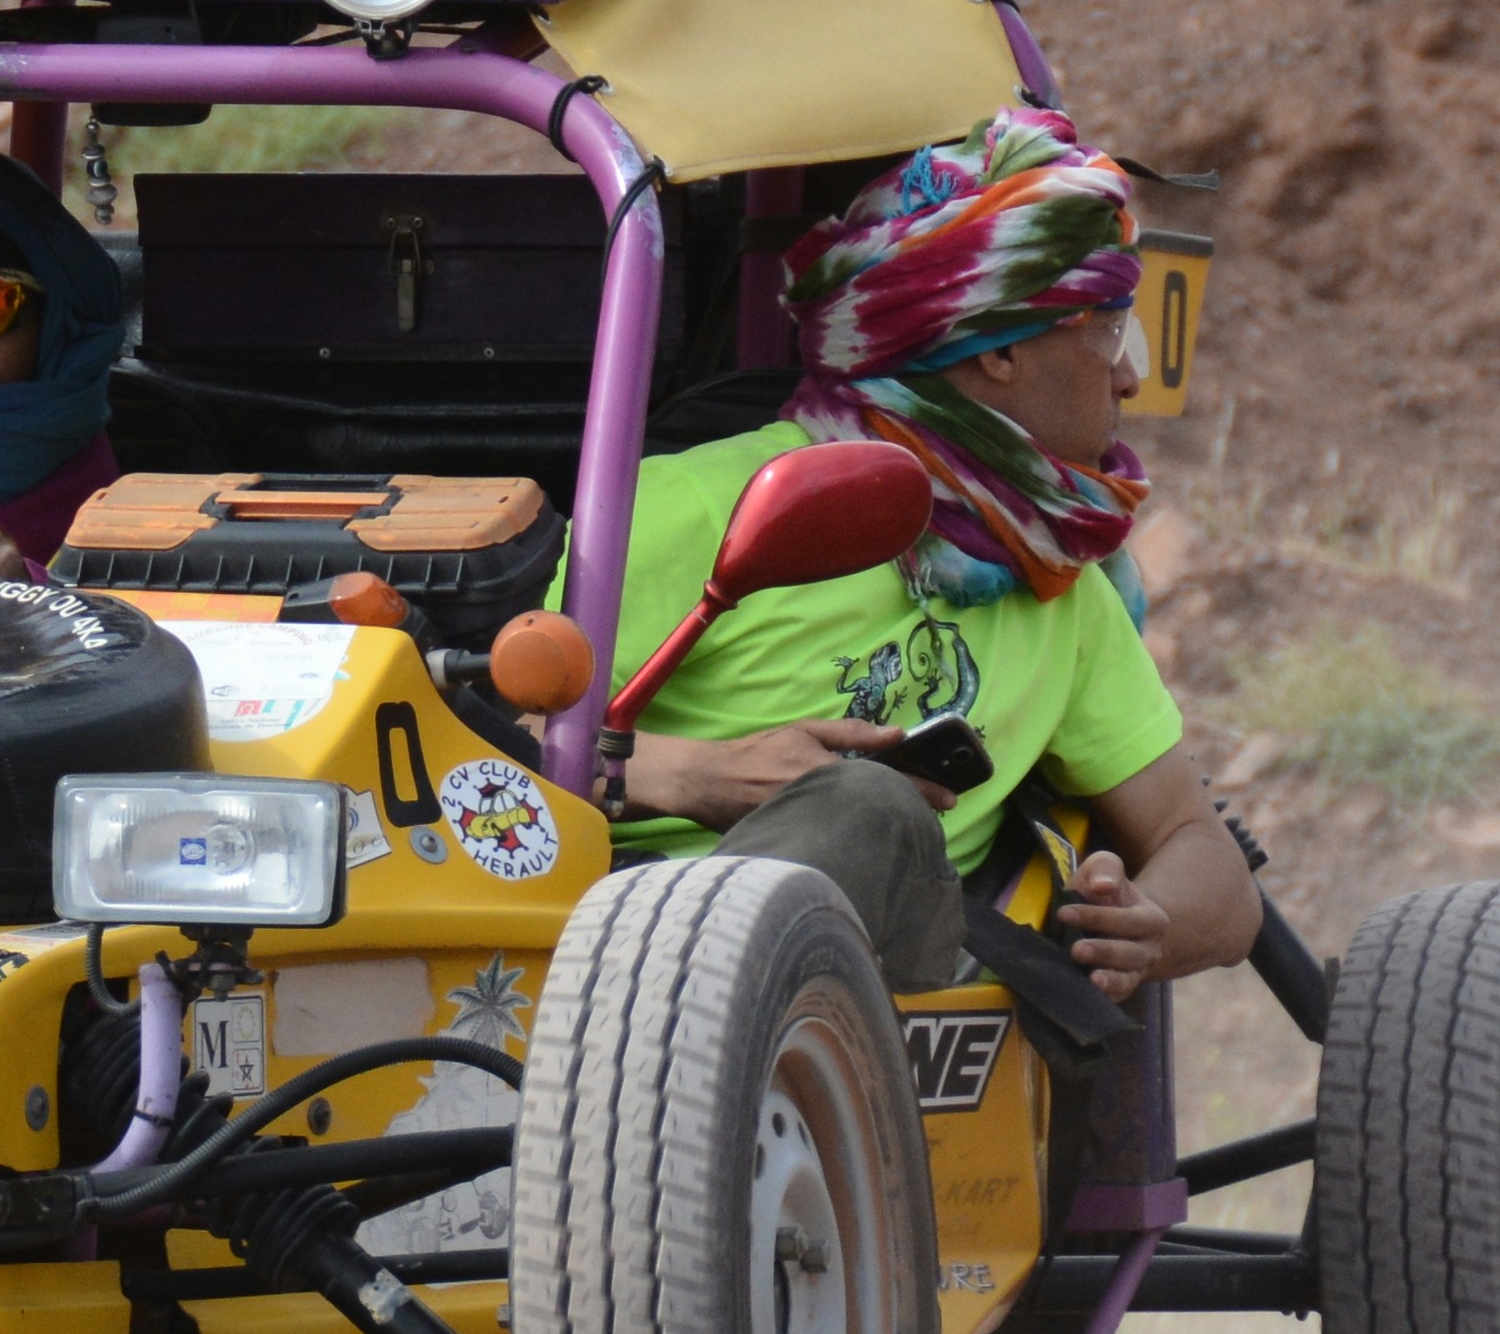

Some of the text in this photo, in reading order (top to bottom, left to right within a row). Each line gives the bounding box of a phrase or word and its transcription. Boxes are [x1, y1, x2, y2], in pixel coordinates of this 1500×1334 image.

[49, 595, 89, 618] OU
[441, 761, 531, 808] 2 CV CLUB
[473, 832, 558, 878] HERAULT
[199, 1020, 229, 1069] M
